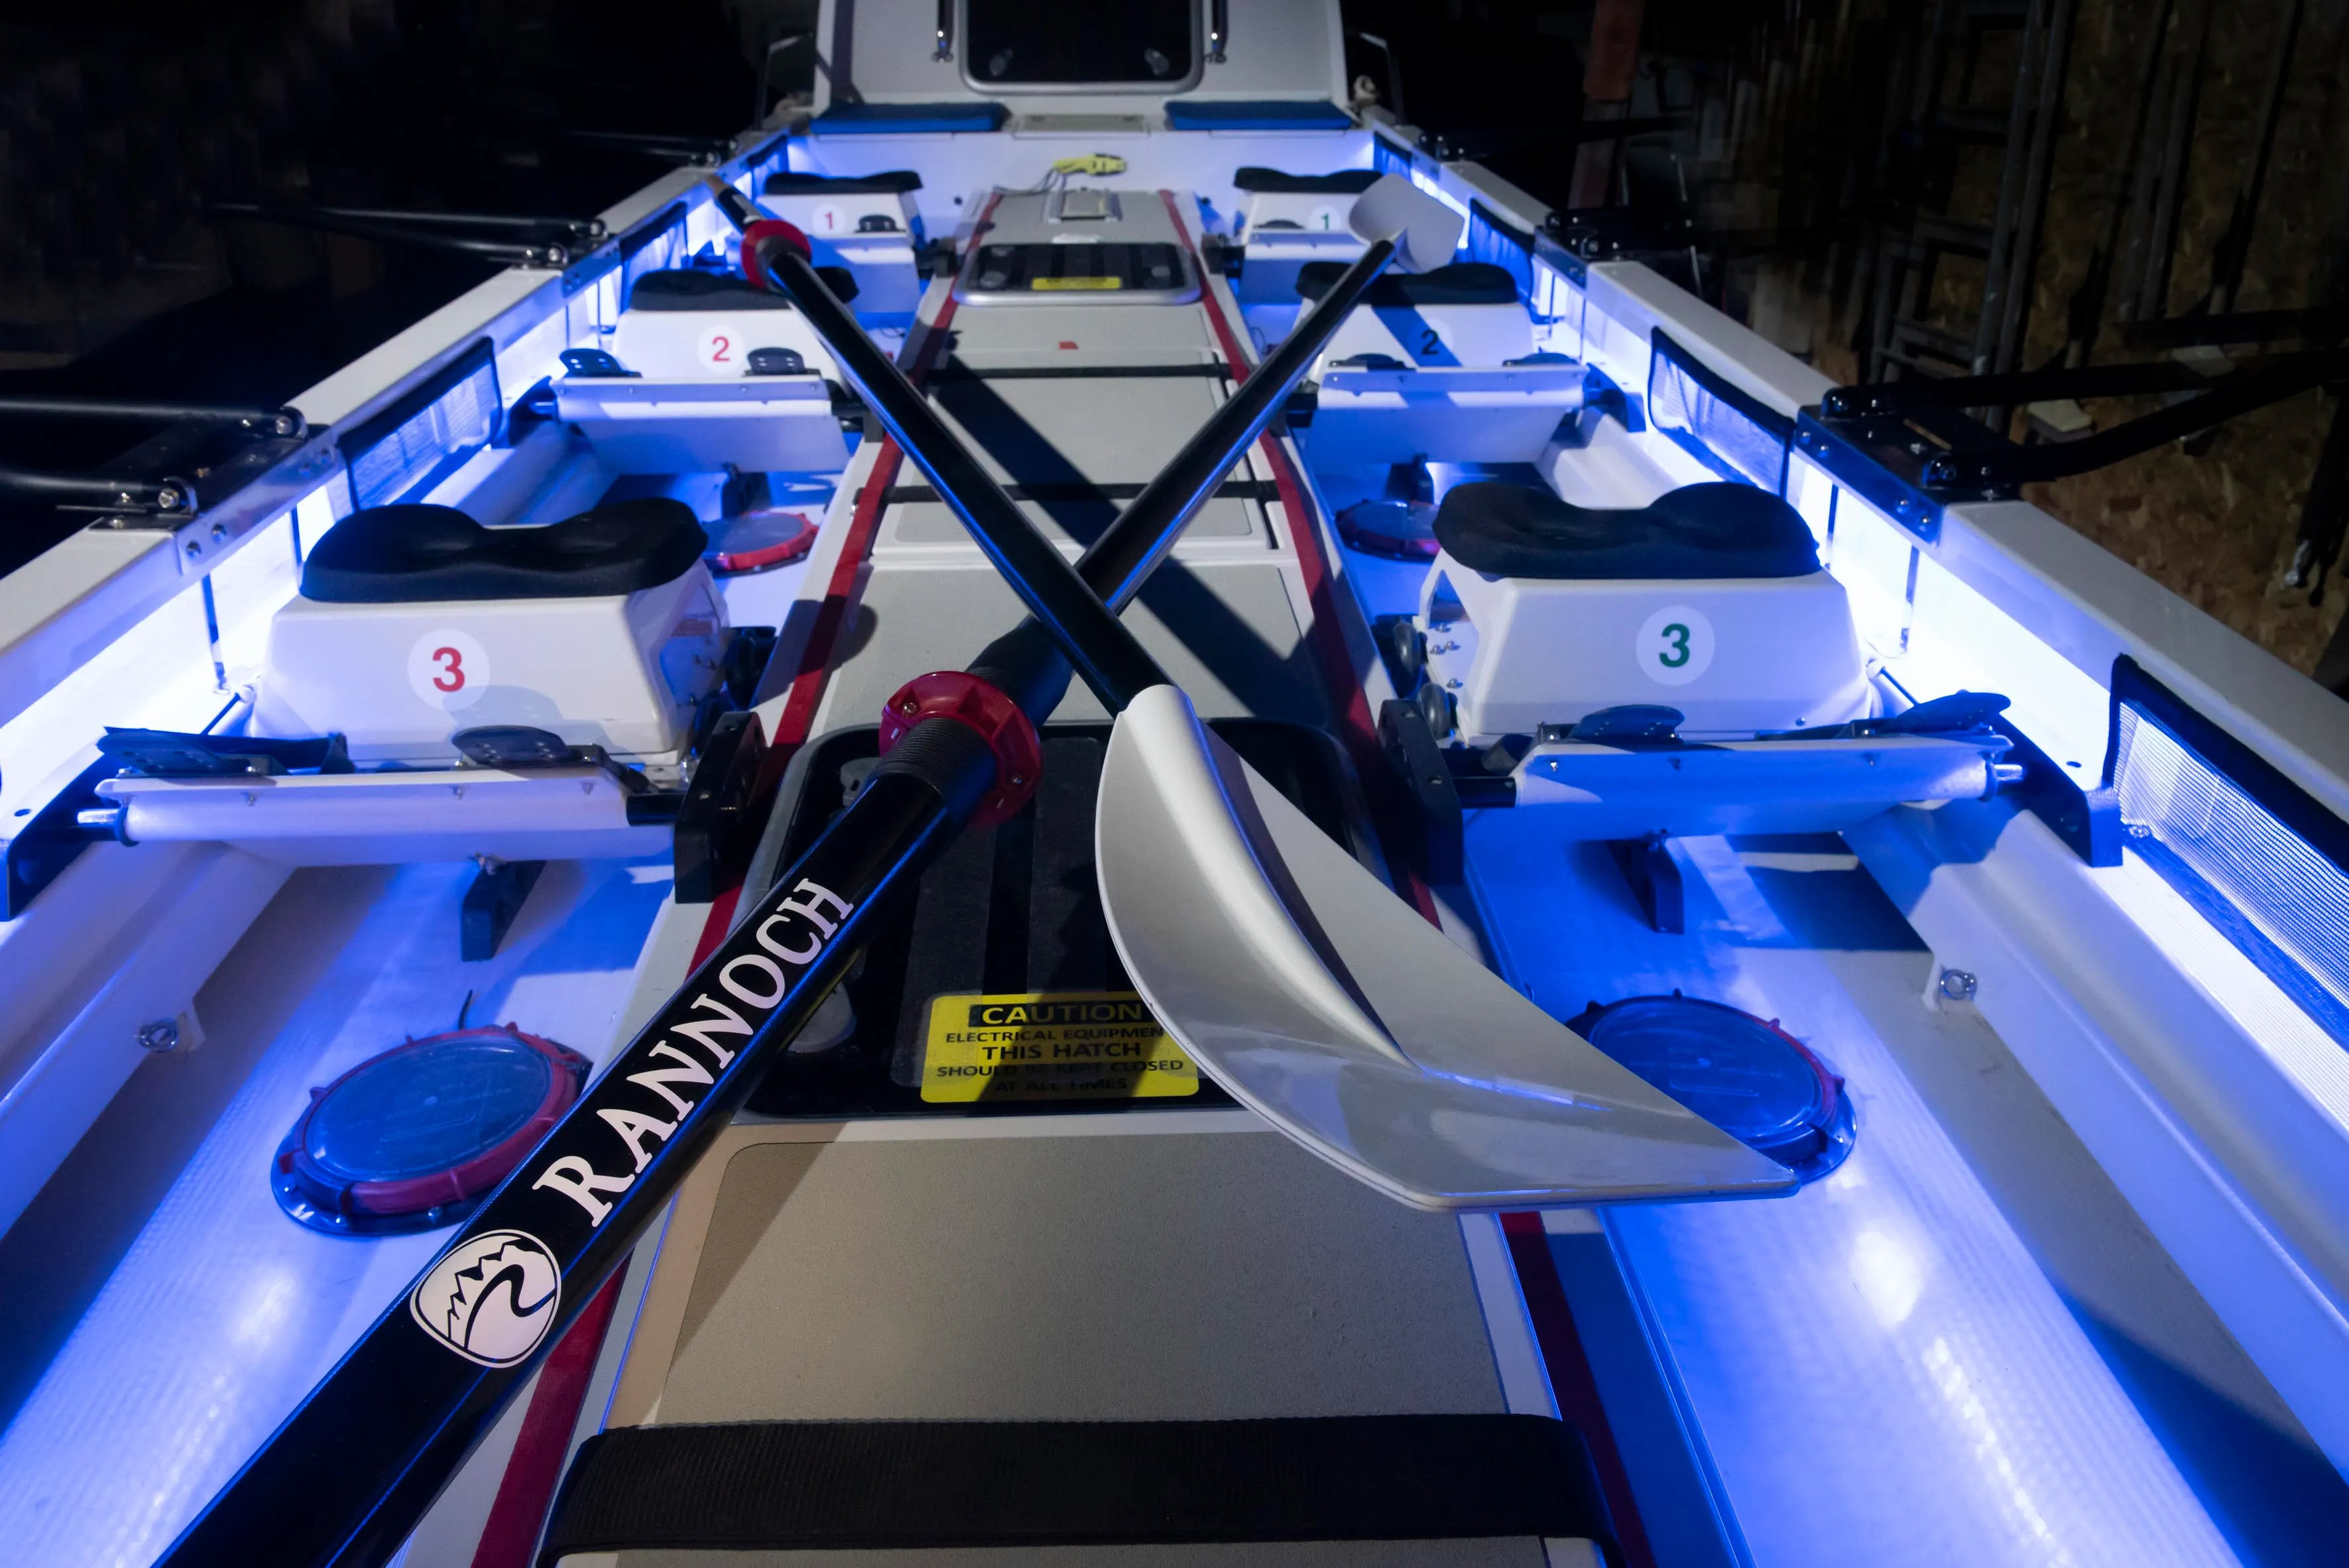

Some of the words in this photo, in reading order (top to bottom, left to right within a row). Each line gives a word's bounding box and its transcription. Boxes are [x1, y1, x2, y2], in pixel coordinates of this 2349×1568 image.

[824, 210, 833, 231] 1
[1321, 213, 1329, 231] 1
[712, 335, 731, 362] 2
[1421, 329, 1439, 355] 2
[1659, 623, 1690, 668] 3
[432, 646, 465, 692] 3
[982, 1004, 1142, 1025] CAUTION
[945, 1031, 1057, 1043] ELECTRICAL
[1063, 1027, 1164, 1040] EQUIPMEN
[532, 877, 854, 1228] RANNOCH
[982, 1045, 1042, 1060] THIS
[1053, 1042, 1141, 1057] HATCH
[937, 1065, 1017, 1077] SHOULD
[1110, 1059, 1184, 1071] CLOSED
